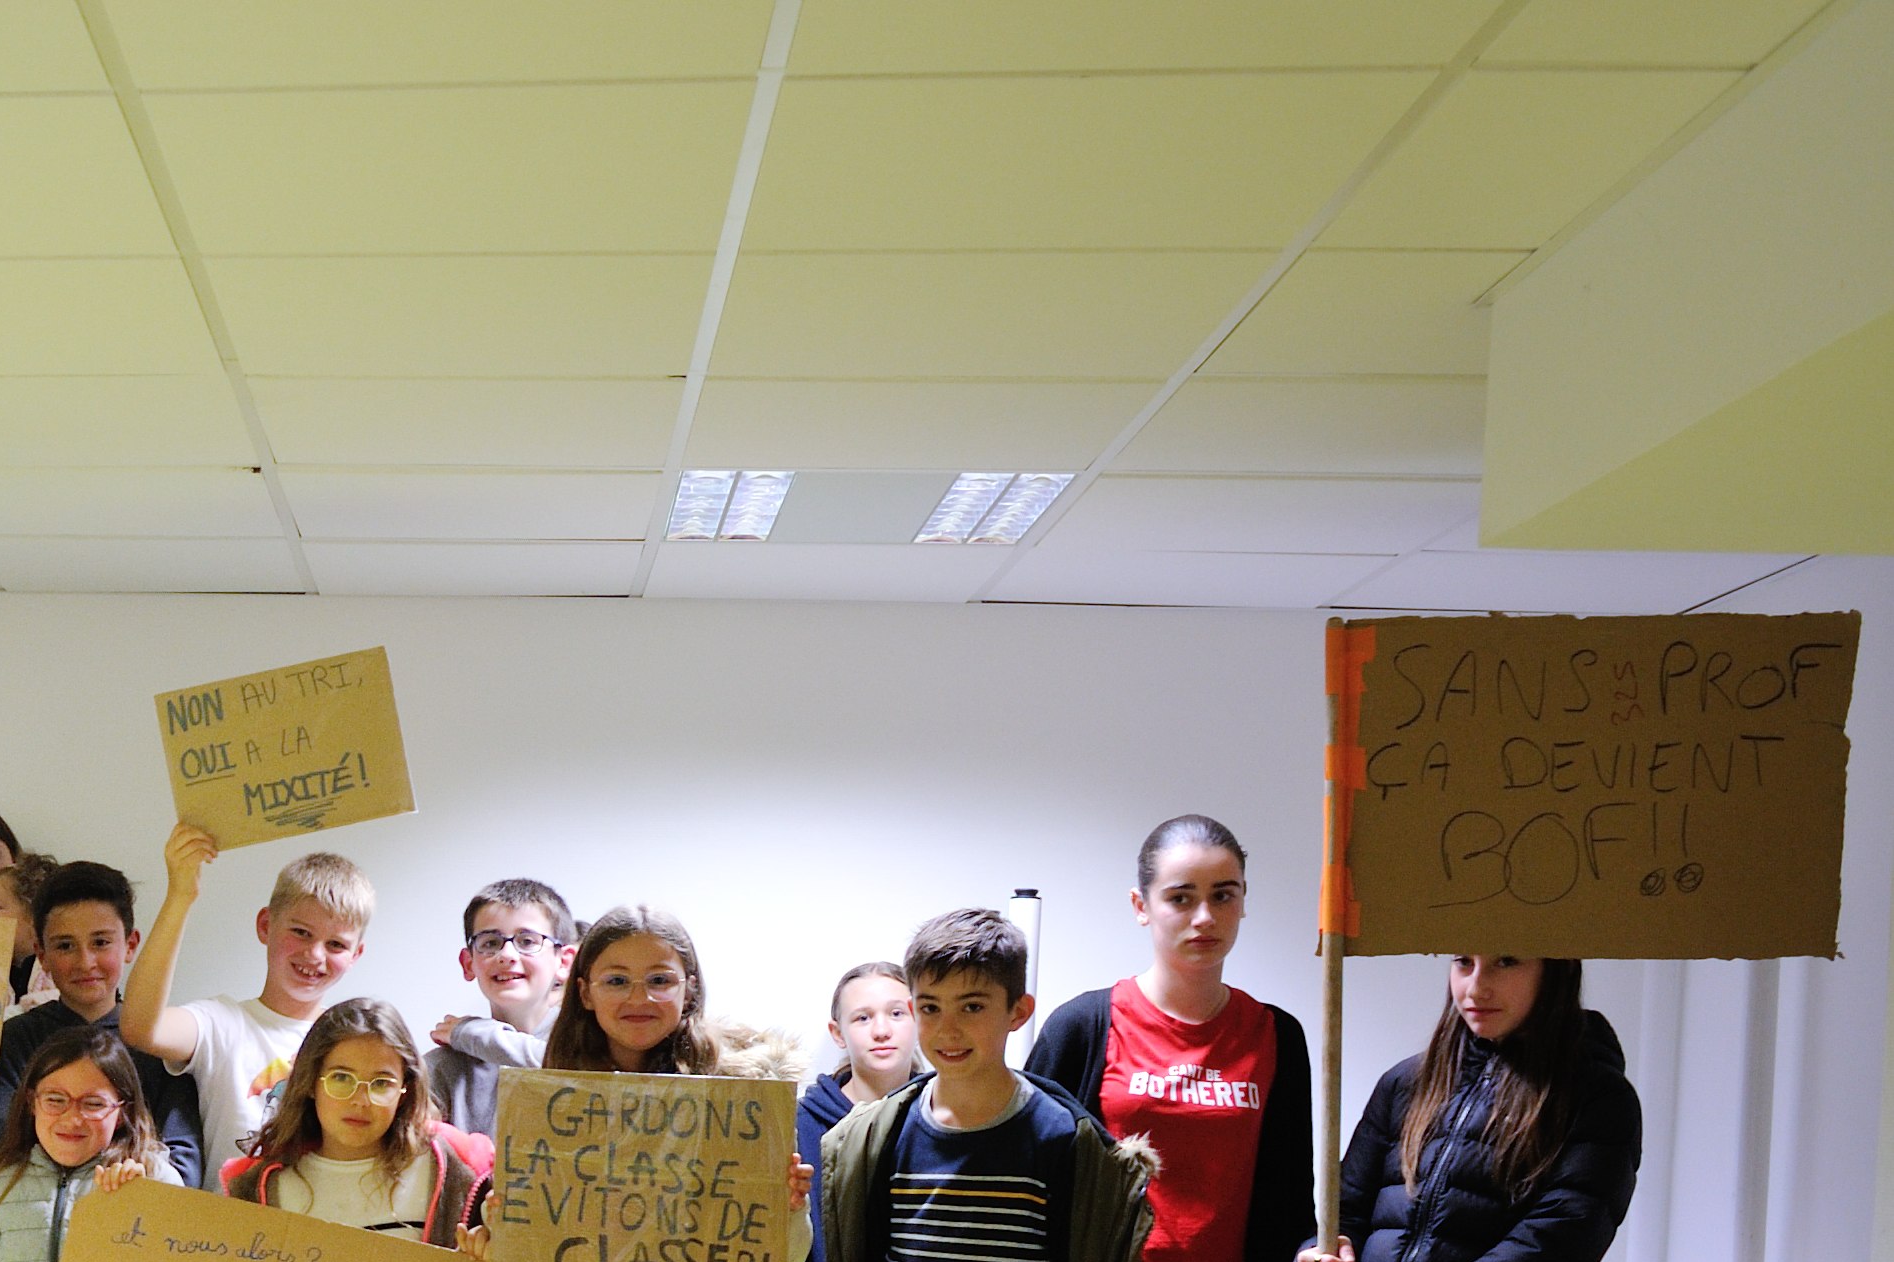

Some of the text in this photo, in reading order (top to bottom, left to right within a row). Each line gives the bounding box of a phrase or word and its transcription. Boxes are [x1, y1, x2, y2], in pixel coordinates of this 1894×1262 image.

[167, 688, 224, 735] NON
[241, 677, 276, 714] AU
[1393, 644, 1598, 730] SANS
[1660, 641, 1844, 716] PROF
[180, 725, 313, 780] OUI A LA
[1366, 734, 1785, 801] ÇA DEVIENT
[1128, 1071, 1260, 1110] BOTHERED
[1205, 1068, 1223, 1081] BE
[546, 1086, 763, 1140] GARDONS
[504, 1135, 740, 1198] LA CLASSE
[110, 1216, 146, 1248] et
[164, 1237, 228, 1256] nous
[717, 1200, 769, 1244] DE
